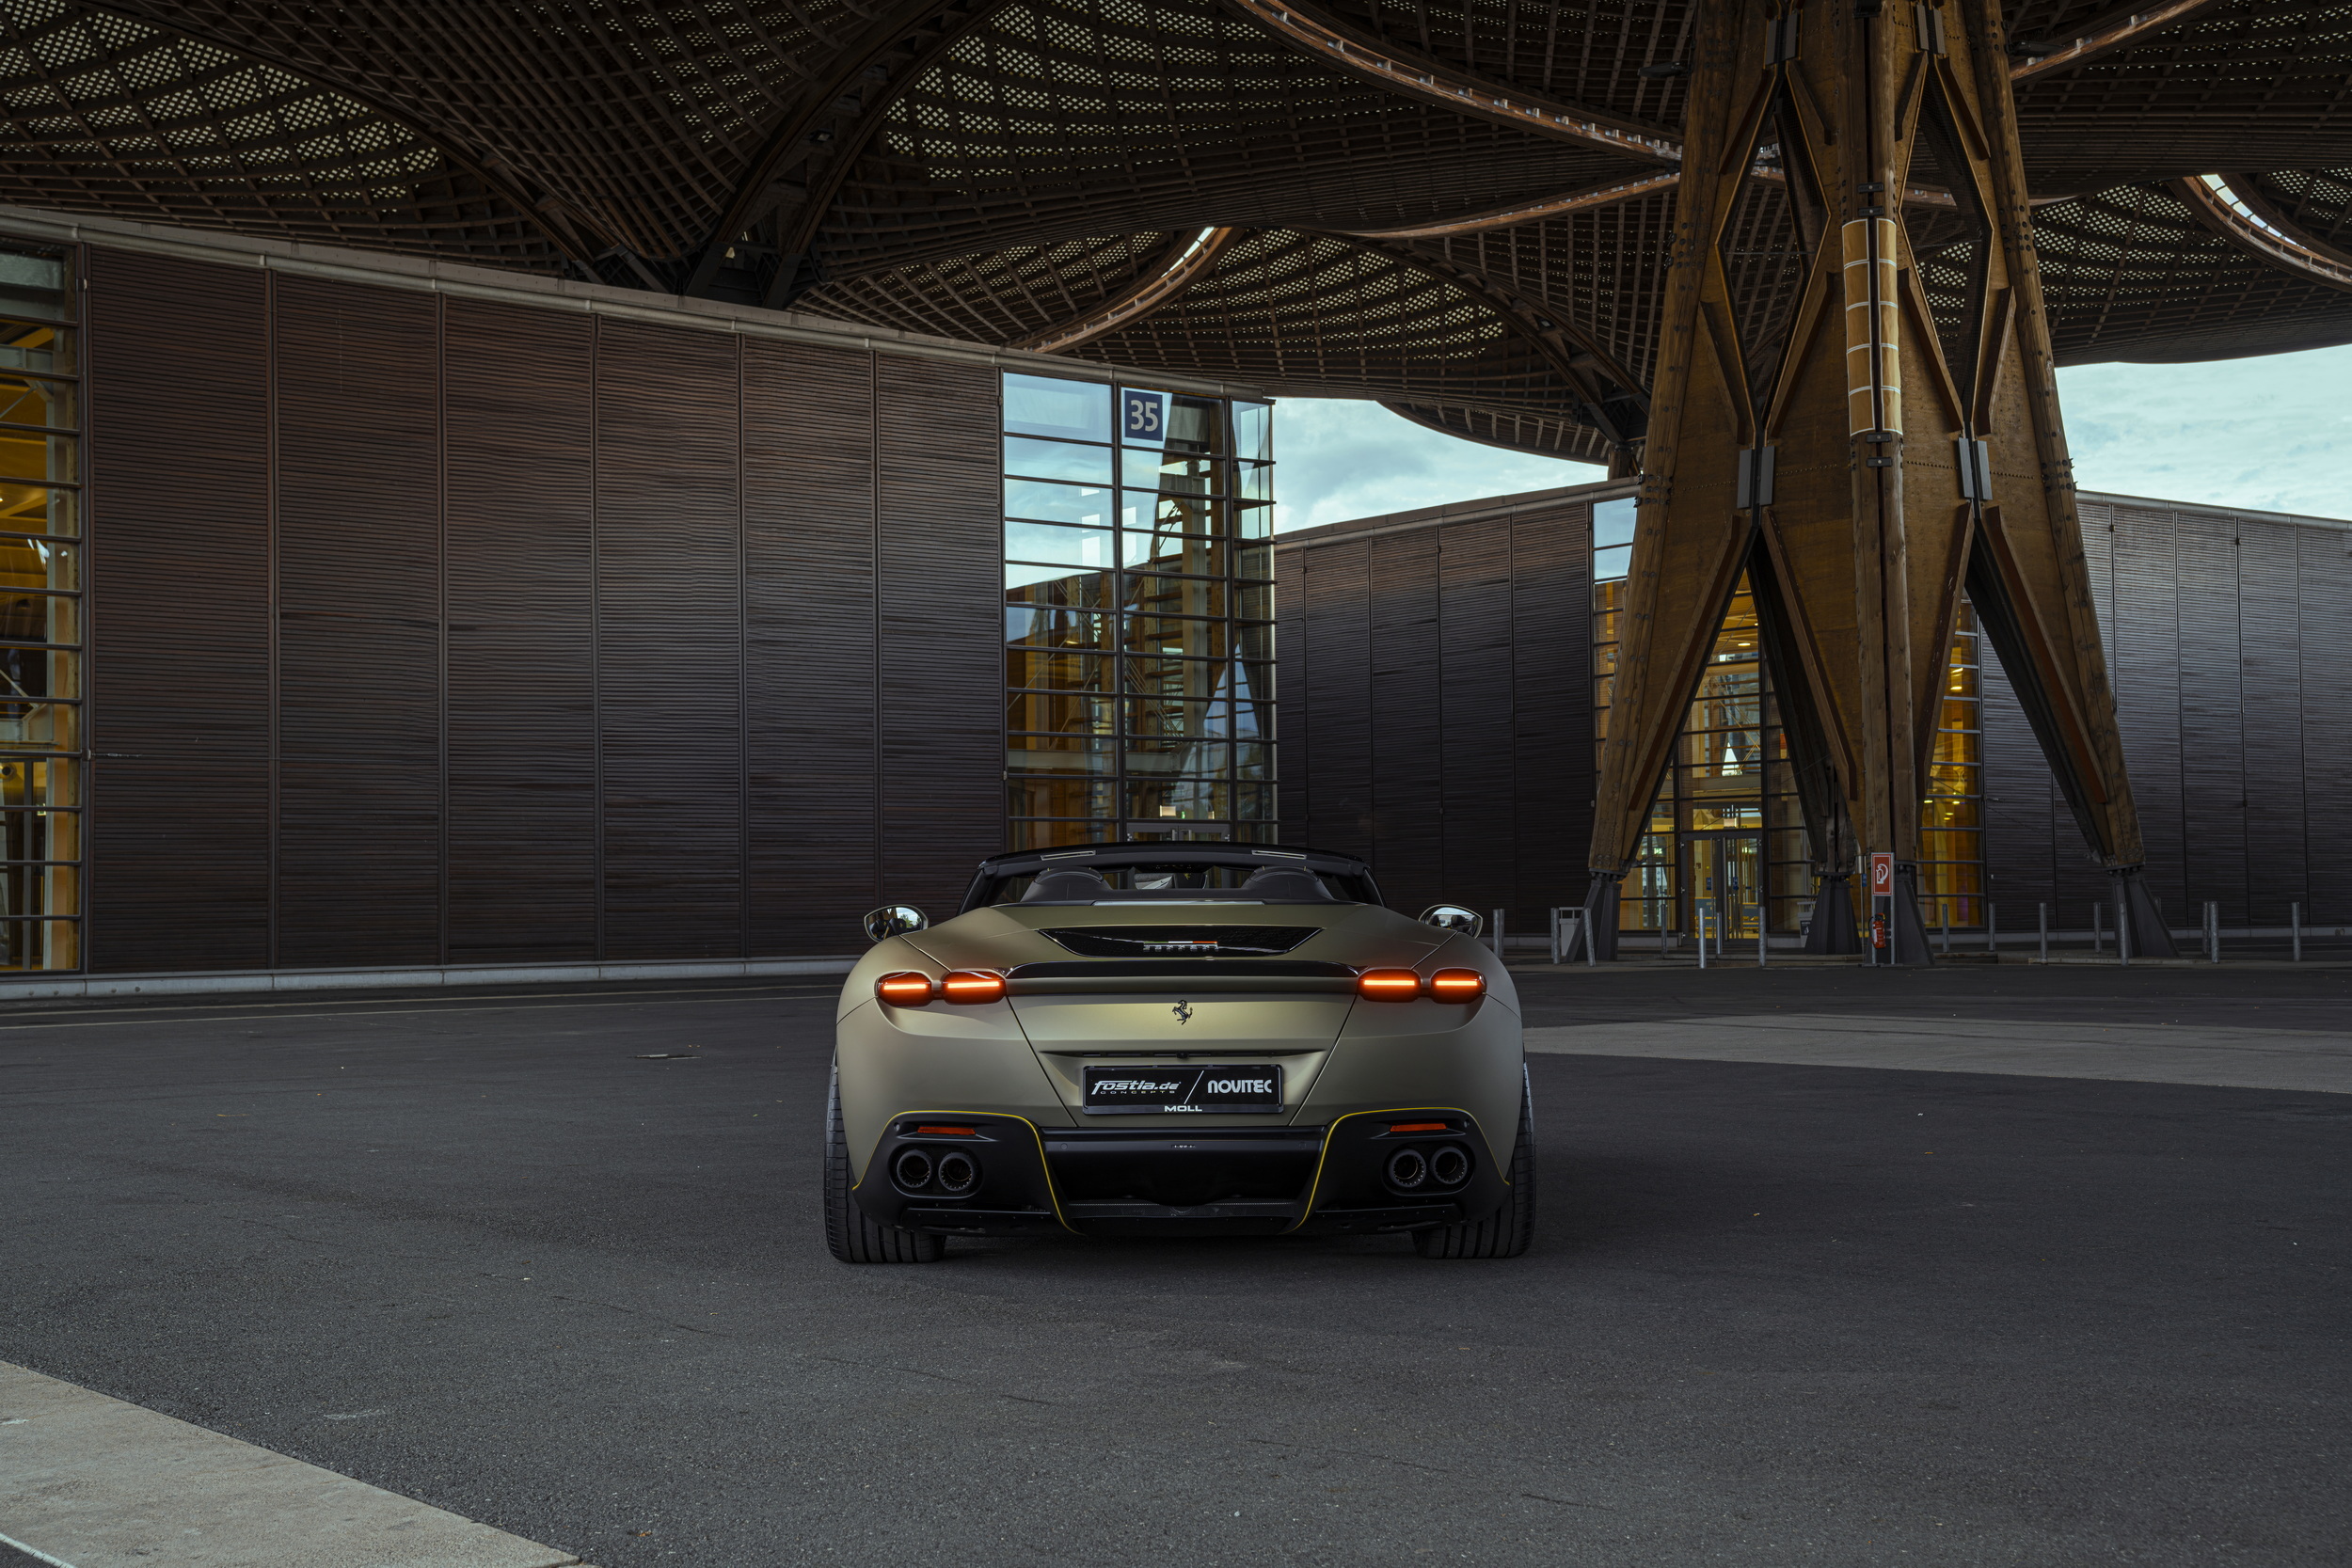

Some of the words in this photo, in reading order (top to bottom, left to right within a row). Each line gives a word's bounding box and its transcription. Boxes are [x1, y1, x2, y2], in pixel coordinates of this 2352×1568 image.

[1130, 400, 1159, 432] 35
[1091, 1080, 1180, 1095] fostla.de
[1207, 1079, 1272, 1094] NOVITEC
